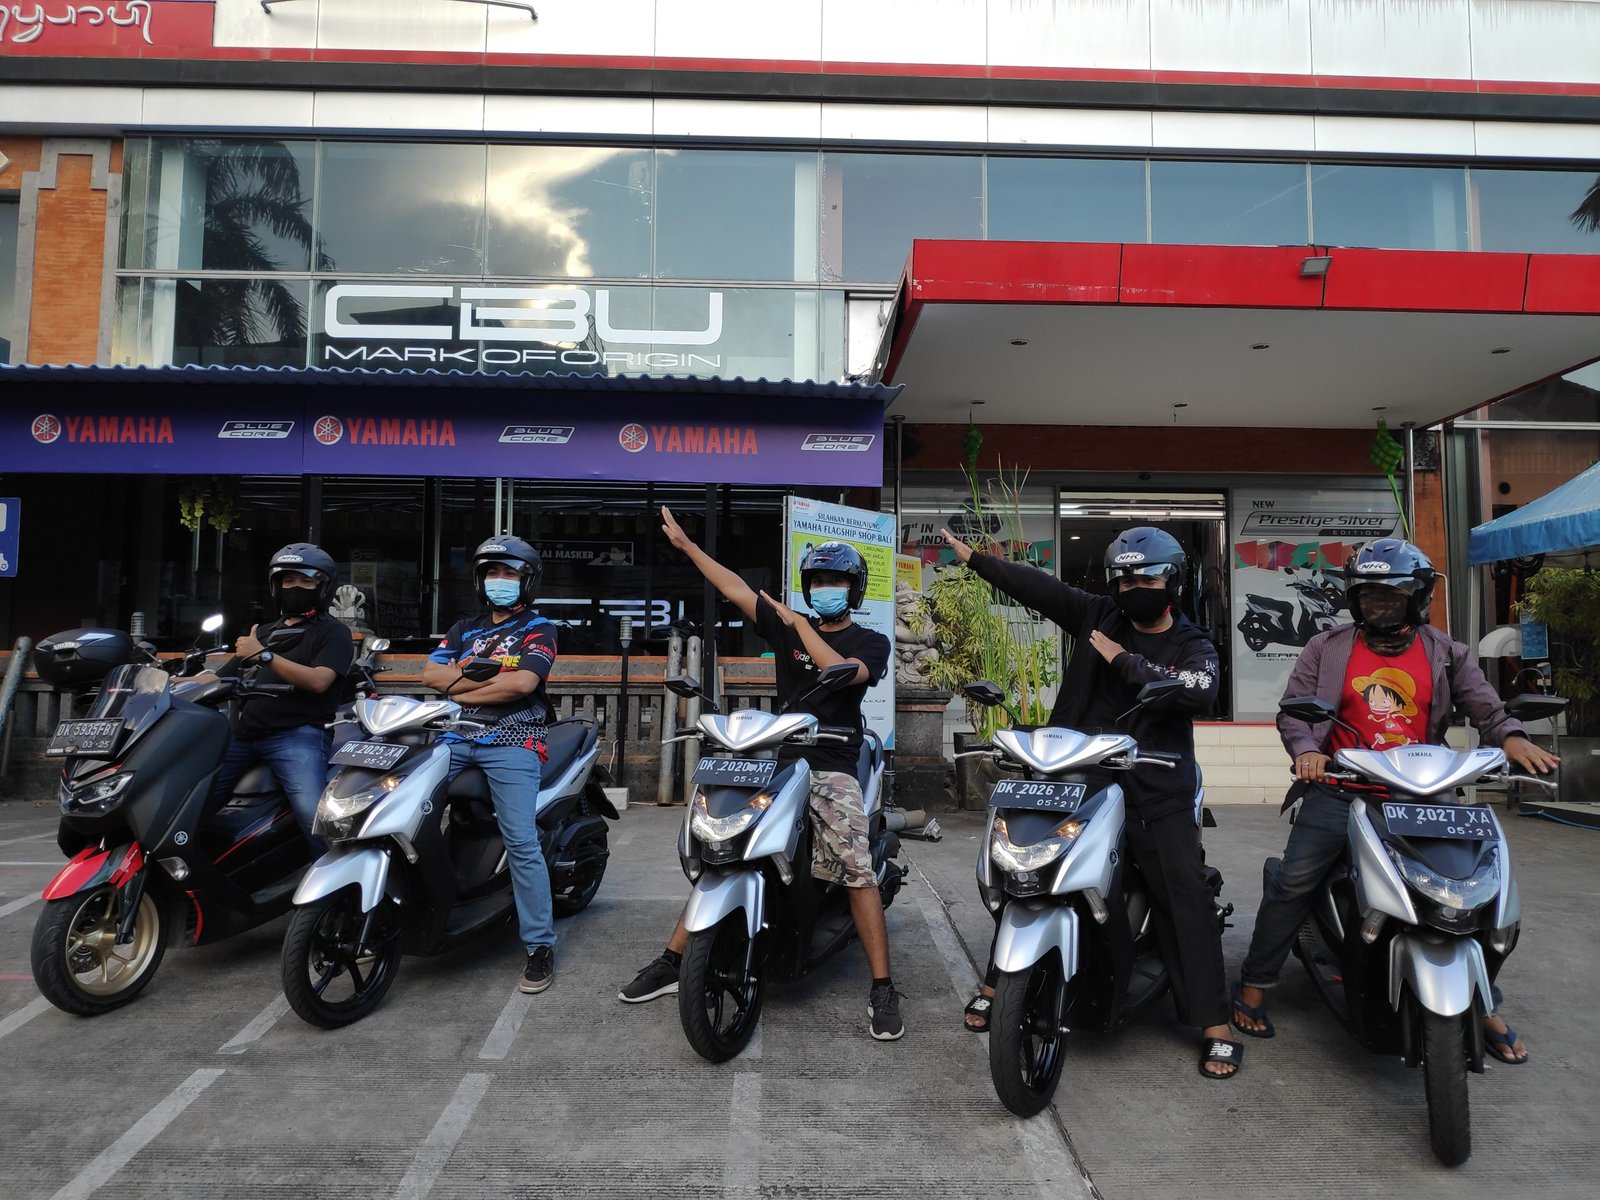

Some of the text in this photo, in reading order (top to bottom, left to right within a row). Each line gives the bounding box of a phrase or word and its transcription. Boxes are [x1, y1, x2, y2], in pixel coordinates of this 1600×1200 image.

[325, 285, 723, 344] CBU
[65, 416, 174, 443] YAMAHA
[347, 418, 456, 446] YAMAHA
[651, 426, 758, 454] YAMAHA
[818, 512, 845, 524] SILAHKAN
[1258, 515, 1388, 528] Prestige Silver
[793, 519, 892, 543] YAMAHA FLAGSHIP SHOP BALI
[921, 523, 933, 533] IN
[555, 550, 594, 559] MASKER
[57, 724, 73, 736] DK
[341, 743, 404, 758] DK 2025 XA
[700, 760, 774, 773] DK 2020 XF
[997, 782, 1080, 798] DK 2026 XA
[1385, 805, 1491, 824] DK 2027 XA
